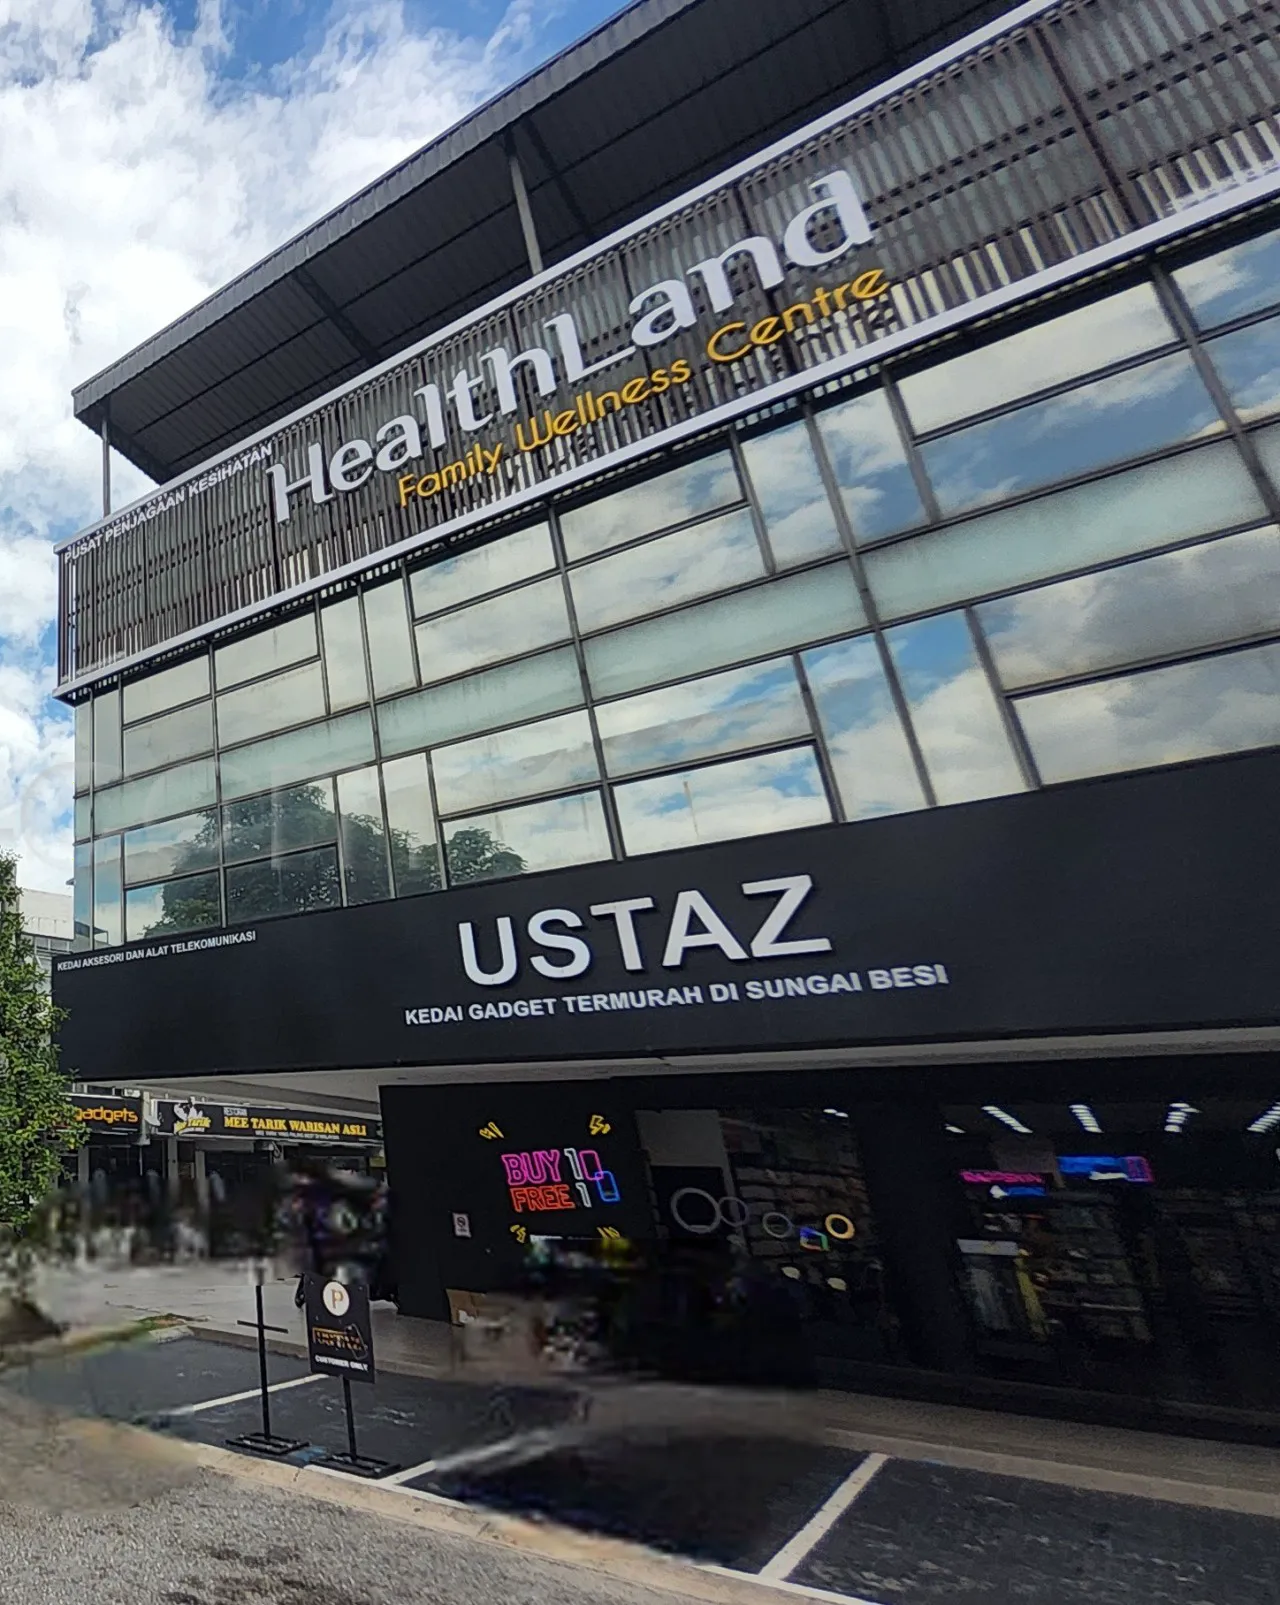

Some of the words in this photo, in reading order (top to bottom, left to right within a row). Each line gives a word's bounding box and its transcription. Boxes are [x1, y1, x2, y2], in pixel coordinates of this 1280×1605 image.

[266, 170, 875, 523] HealthLand
[398, 442, 503, 508] Family
[516, 358, 691, 453] Wellness
[706, 267, 890, 363] Centre
[64, 535, 103, 563] PUSAT
[105, 489, 185, 542] PENJAGAAN
[188, 443, 272, 496] KESIHATAN
[57, 960, 81, 971] KEDAI
[82, 952, 124, 968] AKSESORI
[125, 949, 145, 961] DAN
[146, 945, 169, 958] ALAT
[170, 930, 256, 954] TELEKOMUNIKASI
[458, 874, 833, 987] USTAZ
[404, 1004, 464, 1026] KEDAI
[468, 998, 557, 1021] GADGET
[561, 985, 705, 1015] TERMURAH
[709, 982, 740, 1002] DI
[745, 972, 862, 1001] SUNGAI
[867, 963, 949, 991] BESI
[224, 1116, 249, 1128] MEE
[251, 1118, 288, 1131] TARIK
[289, 1120, 341, 1135] WARISAN
[342, 1123, 367, 1137] ASLI
[502, 1149, 562, 1186] BUY
[564, 1148, 584, 1181] 1
[509, 1183, 576, 1213] FREE
[576, 1182, 592, 1208] 1
[331, 1288, 344, 1309] P
